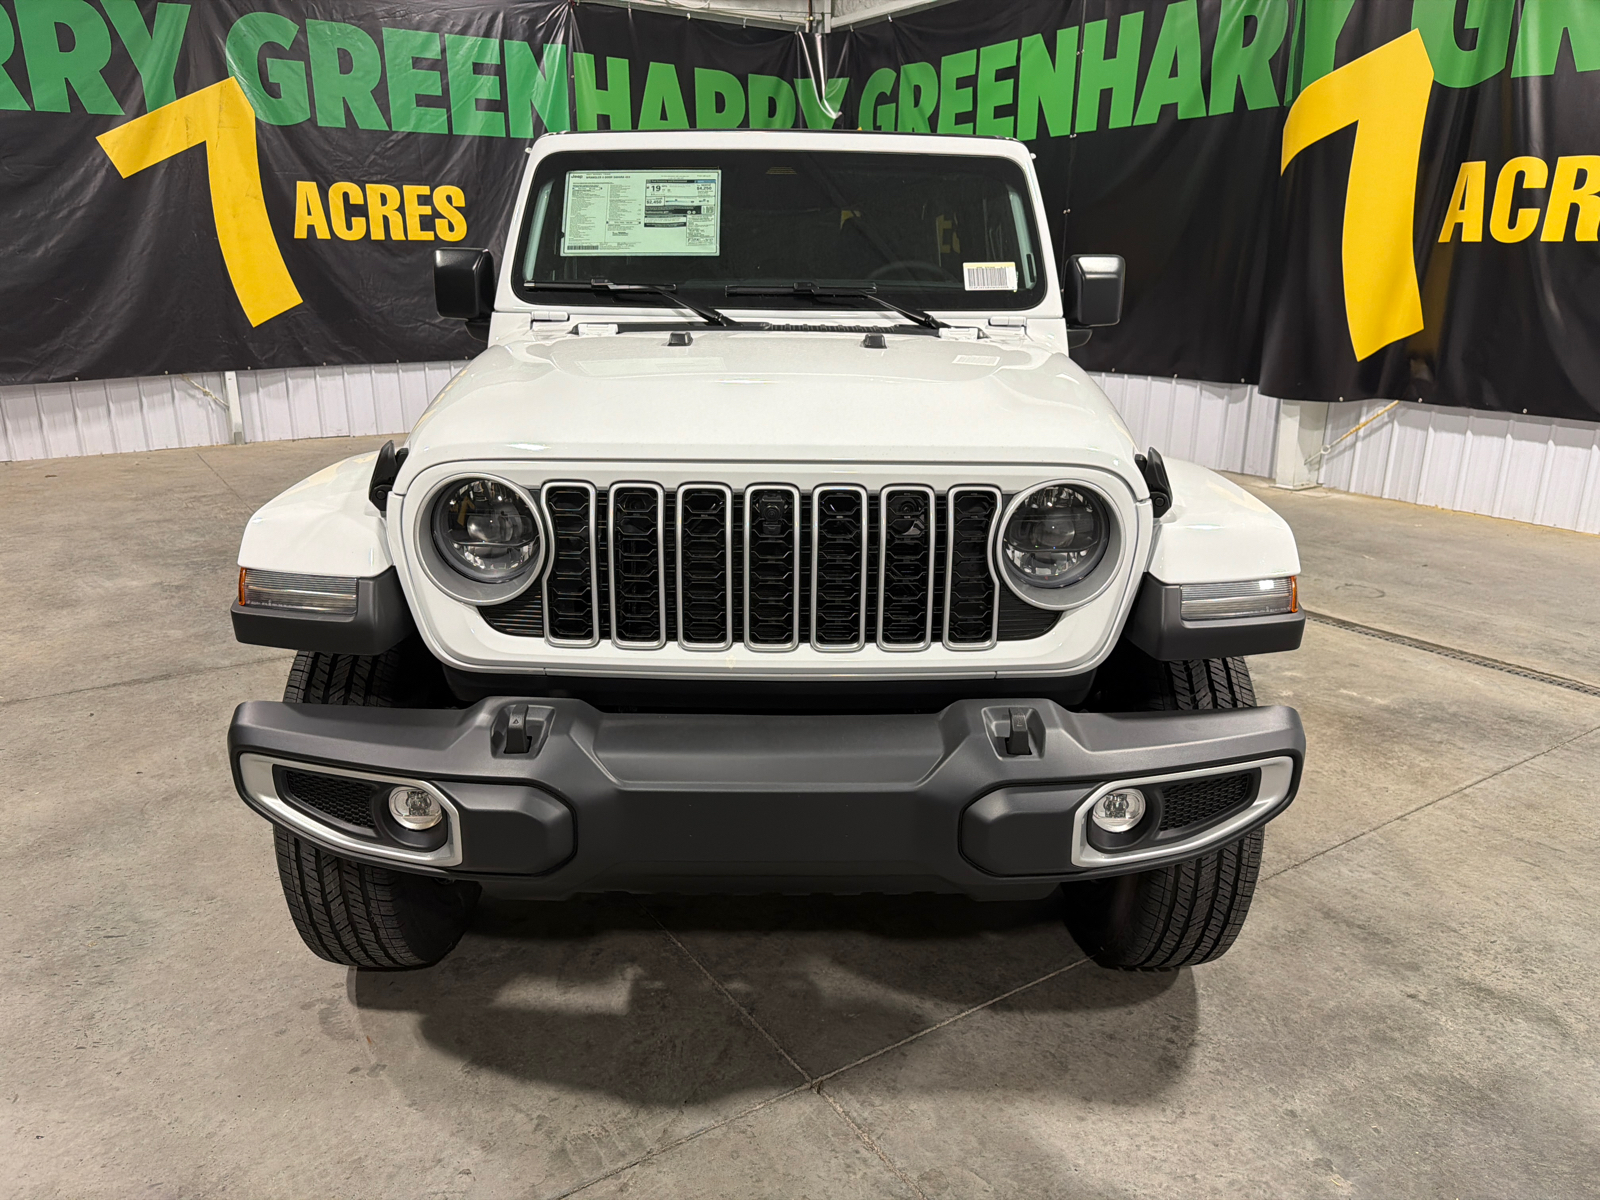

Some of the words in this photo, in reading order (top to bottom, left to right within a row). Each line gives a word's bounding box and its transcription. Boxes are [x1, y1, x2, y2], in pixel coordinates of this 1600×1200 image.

[226, 12, 570, 138] GREEN
[858, 26, 1079, 141] GREEN
[96, 76, 303, 327] 7
[294, 181, 468, 241] ACRES
[1281, 28, 1434, 361] 7
